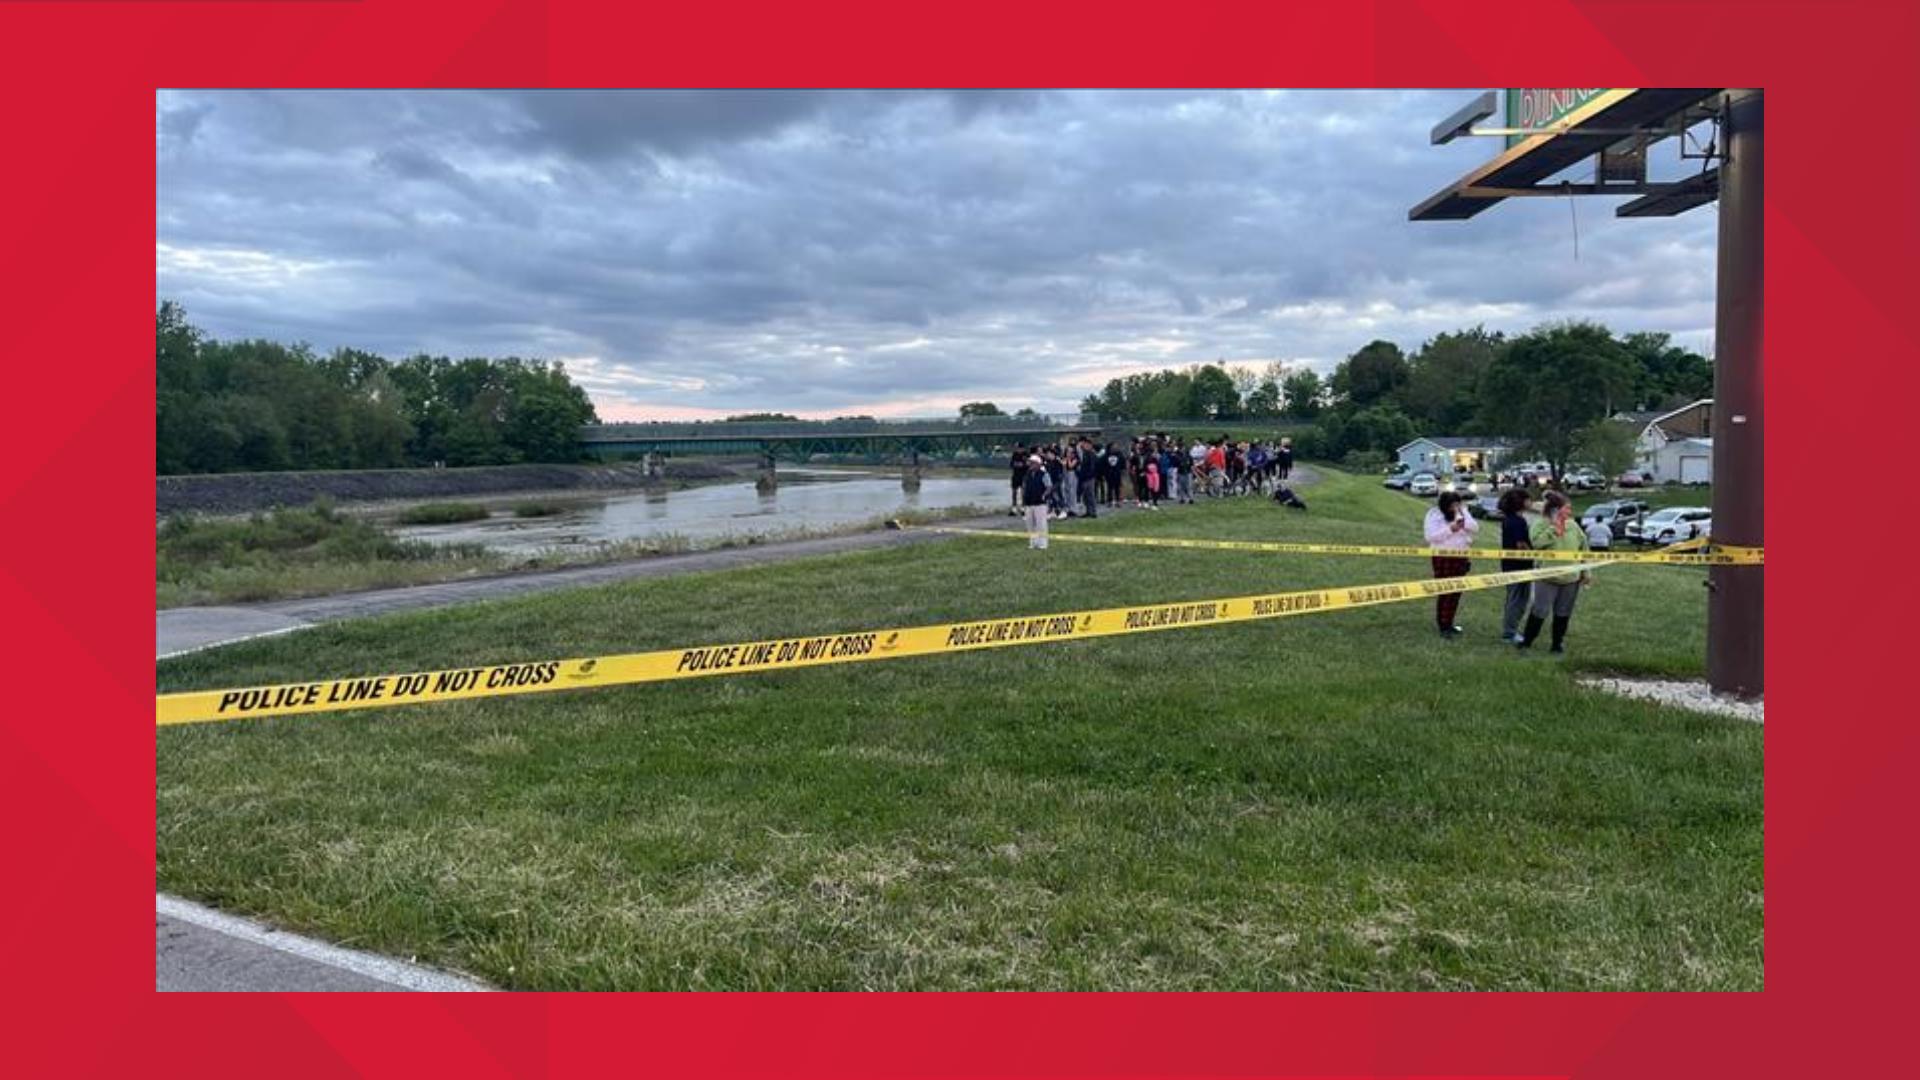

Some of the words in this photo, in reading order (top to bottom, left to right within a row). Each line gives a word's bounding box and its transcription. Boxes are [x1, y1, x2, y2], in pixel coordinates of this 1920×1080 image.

[1520, 88, 1600, 132] DINN
[946, 624, 987, 646] POLICE
[985, 622, 1011, 641] LINE
[1008, 621, 1026, 640] DO
[1023, 619, 1047, 638] NOT
[1045, 616, 1077, 635] CROSS
[1125, 609, 1153, 628] POLICE
[1153, 608, 1169, 625] LINE
[676, 647, 740, 672] POLICE
[739, 643, 777, 664] LINE
[774, 642, 800, 662] DO
[799, 638, 832, 660] NOT
[831, 633, 876, 657] CROSS
[218, 684, 323, 712] POLICE
[326, 677, 388, 703] LINE
[392, 674, 429, 697] DO
[432, 669, 485, 693] NOT
[486, 662, 560, 688] CROSS
